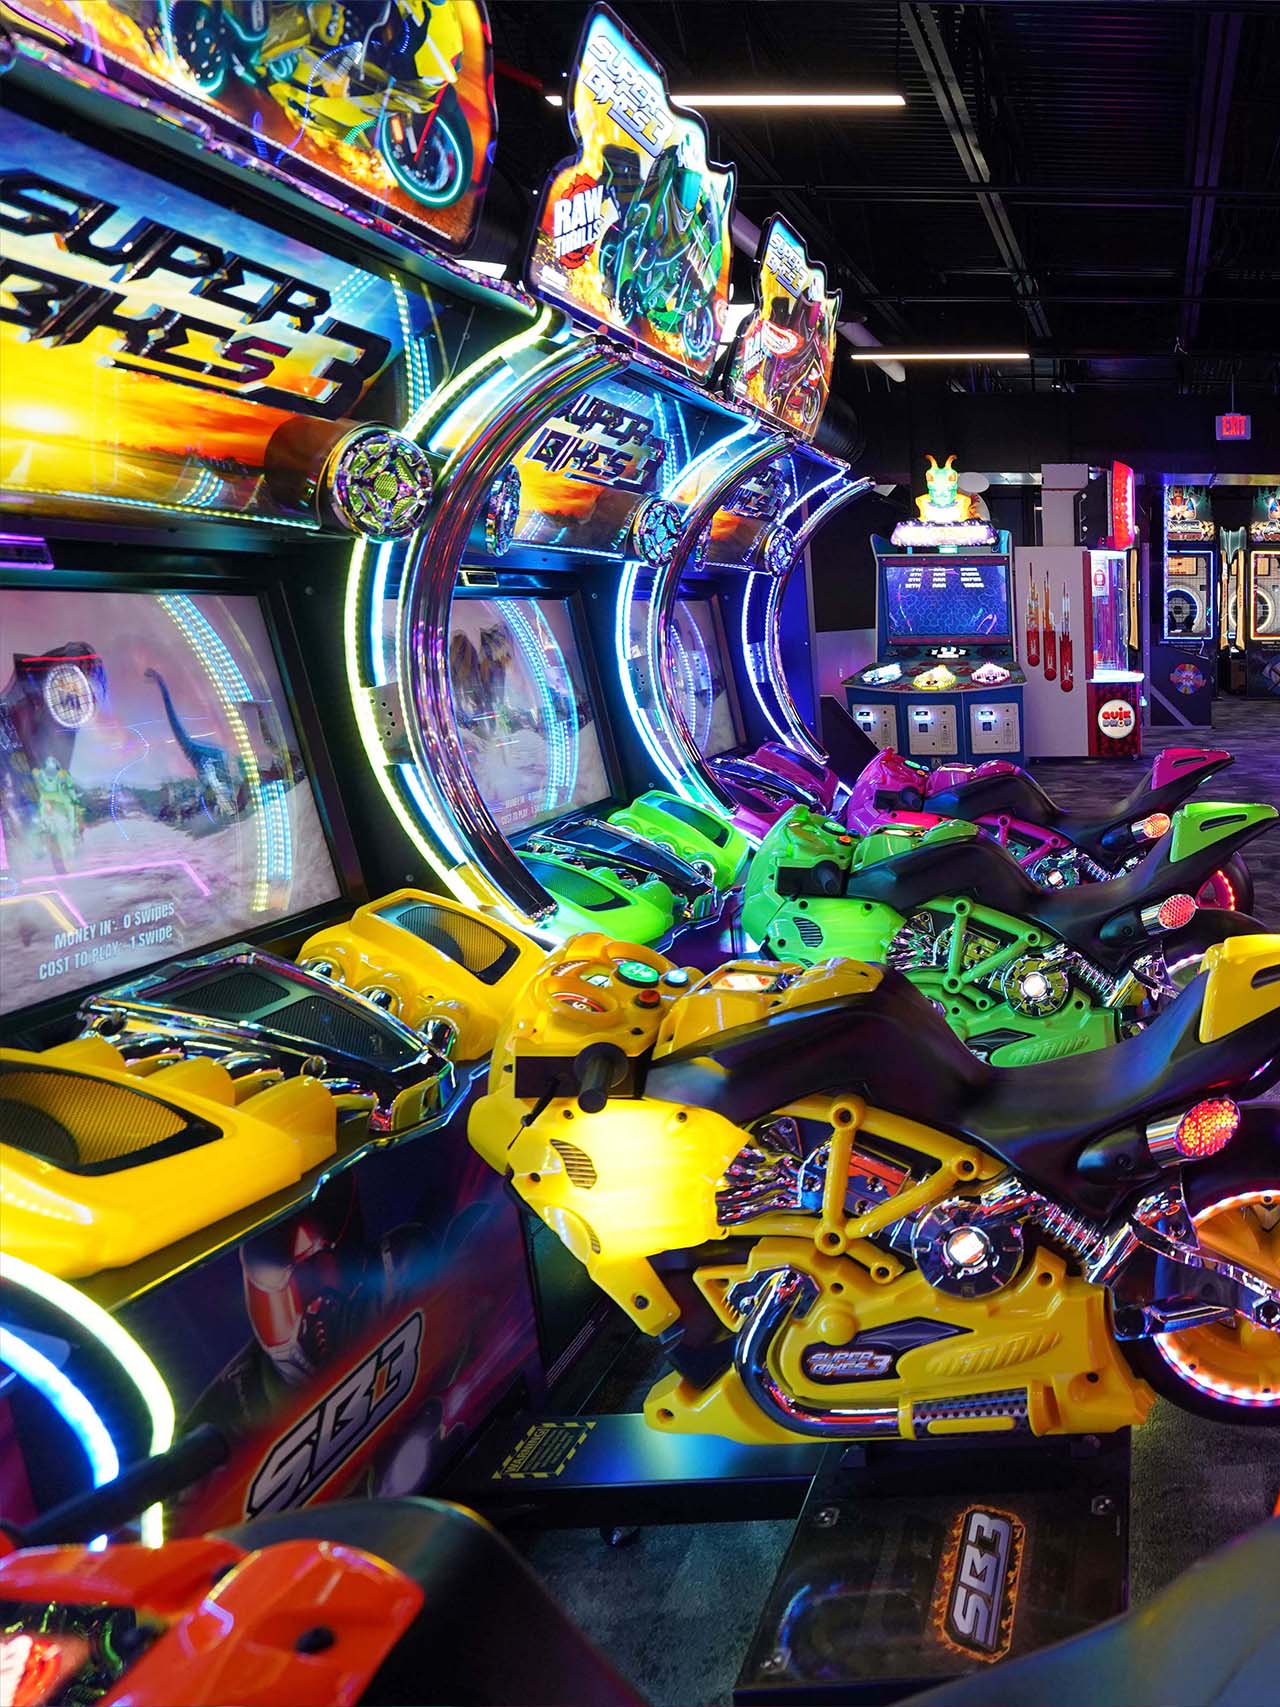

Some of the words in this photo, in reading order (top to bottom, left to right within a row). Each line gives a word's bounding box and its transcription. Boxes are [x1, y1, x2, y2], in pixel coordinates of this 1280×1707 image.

[554, 185, 604, 237] RAW
[0, 168, 332, 333] SUPER
[1221, 415, 1246, 436] EXIT
[54, 924, 96, 950] MONEY
[123, 913, 131, 929] 0
[39, 956, 69, 980] COST
[75, 950, 88, 969] TO
[807, 1351, 874, 1364] SUPER
[952, 1512, 1012, 1650] SB3
